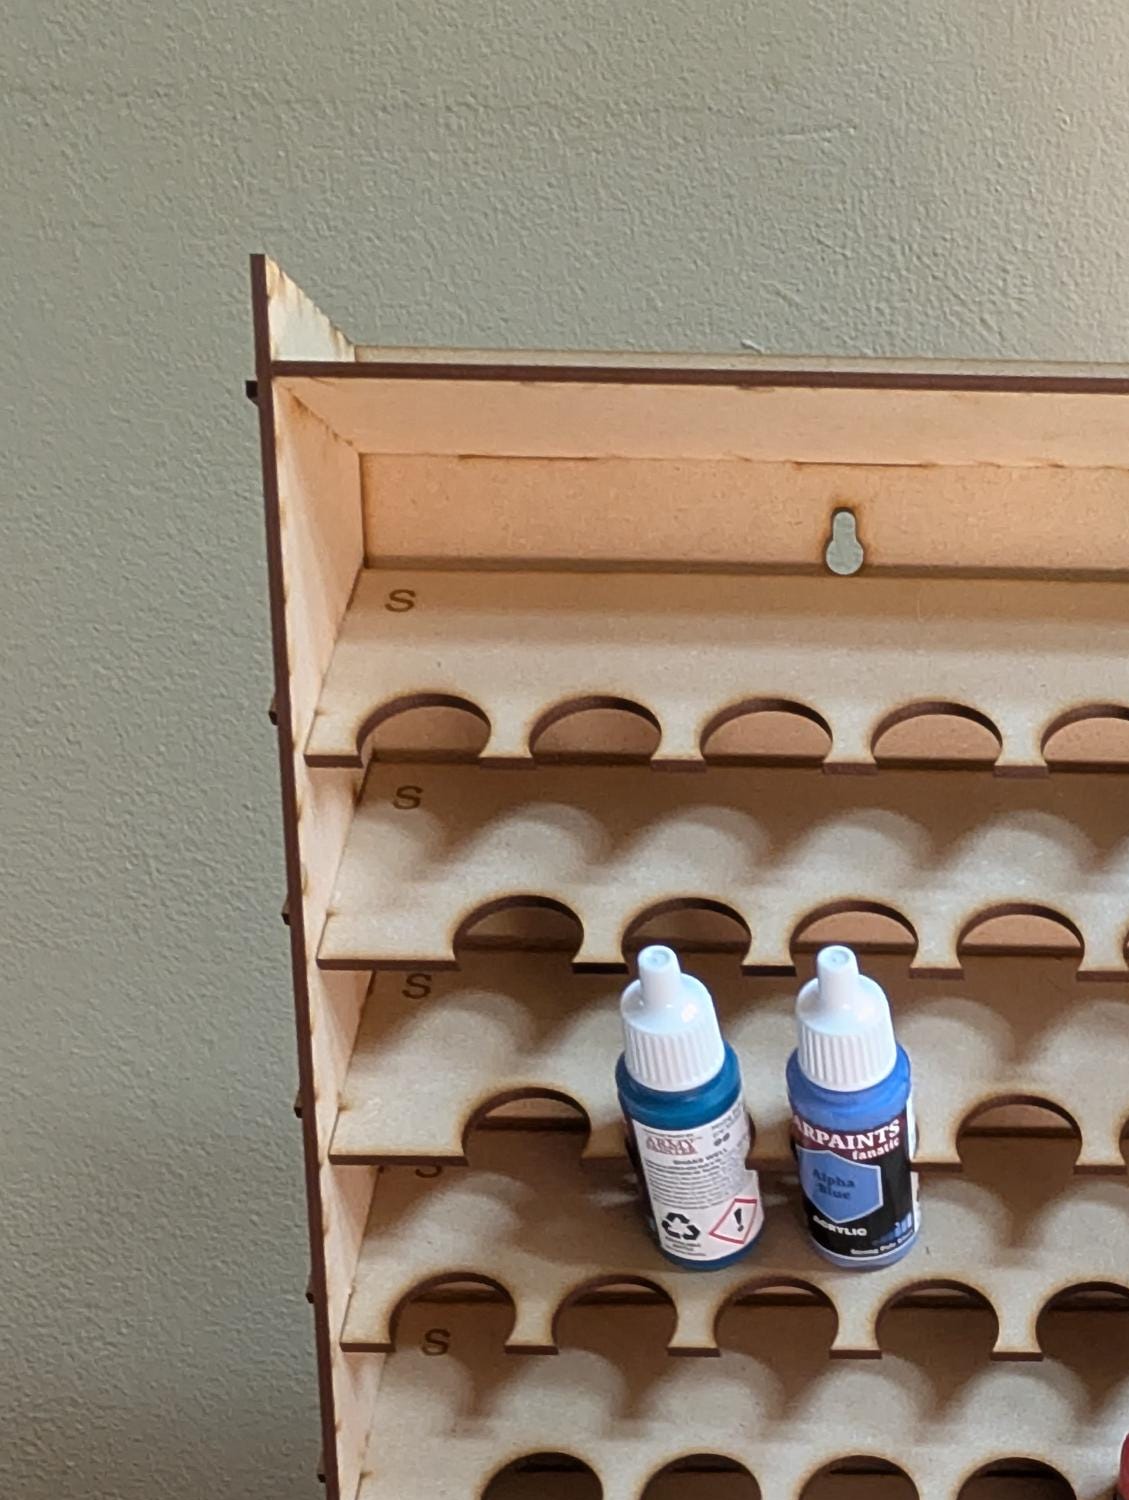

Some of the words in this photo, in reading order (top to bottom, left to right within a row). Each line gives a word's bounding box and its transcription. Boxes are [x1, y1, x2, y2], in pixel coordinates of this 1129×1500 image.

[384, 588, 417, 613] S
[392, 784, 424, 810] S
[401, 972, 433, 999] S
[852, 1136, 900, 1160] fanatic
[812, 1168, 856, 1189] Alpha
[816, 1183, 852, 1200] Blue
[421, 1328, 450, 1356] S
